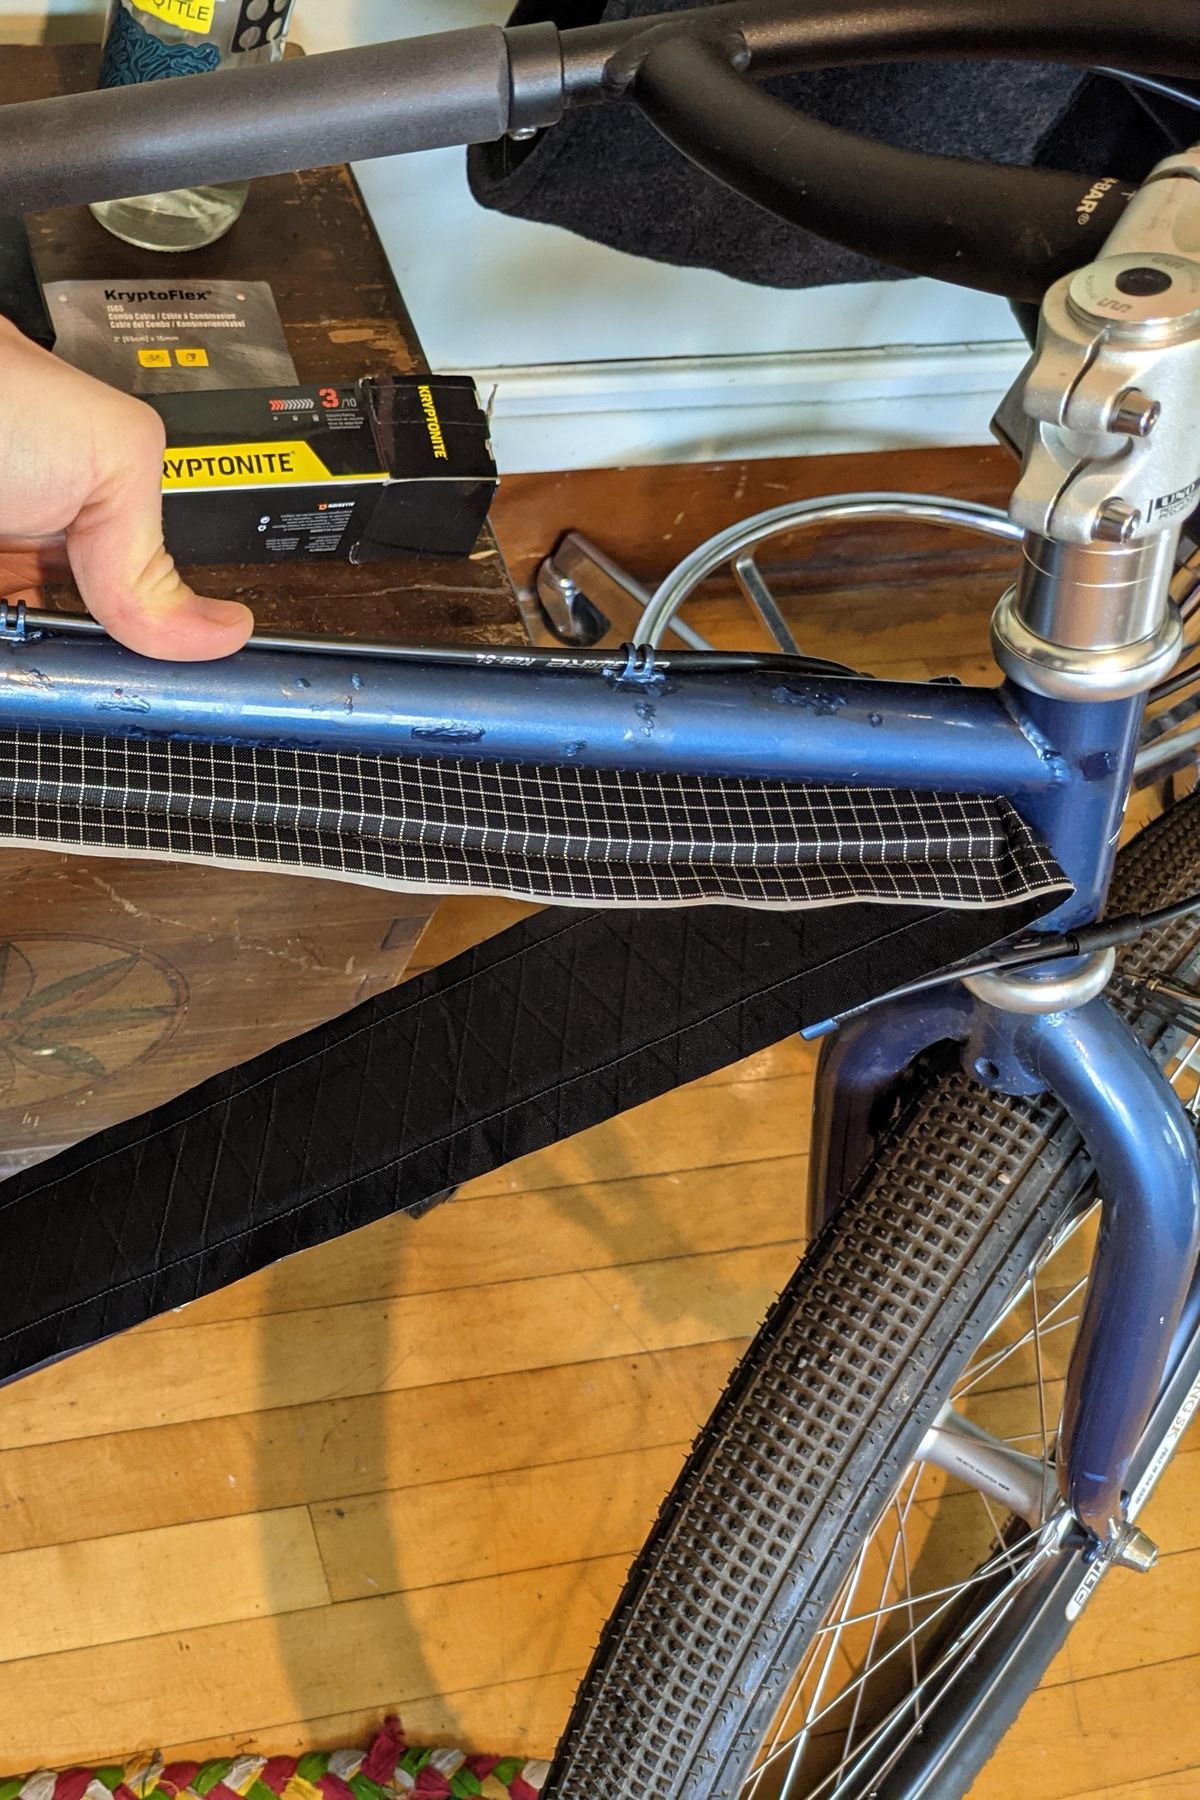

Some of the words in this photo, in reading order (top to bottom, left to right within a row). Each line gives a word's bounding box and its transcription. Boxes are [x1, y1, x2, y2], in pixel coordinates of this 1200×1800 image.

[104, 290, 208, 302] KryptoFlex
[108, 312, 133, 320] Combo
[318, 387, 339, 408] 3
[417, 385, 446, 459] KRYPTONITE
[163, 453, 294, 478] YPTONITE
